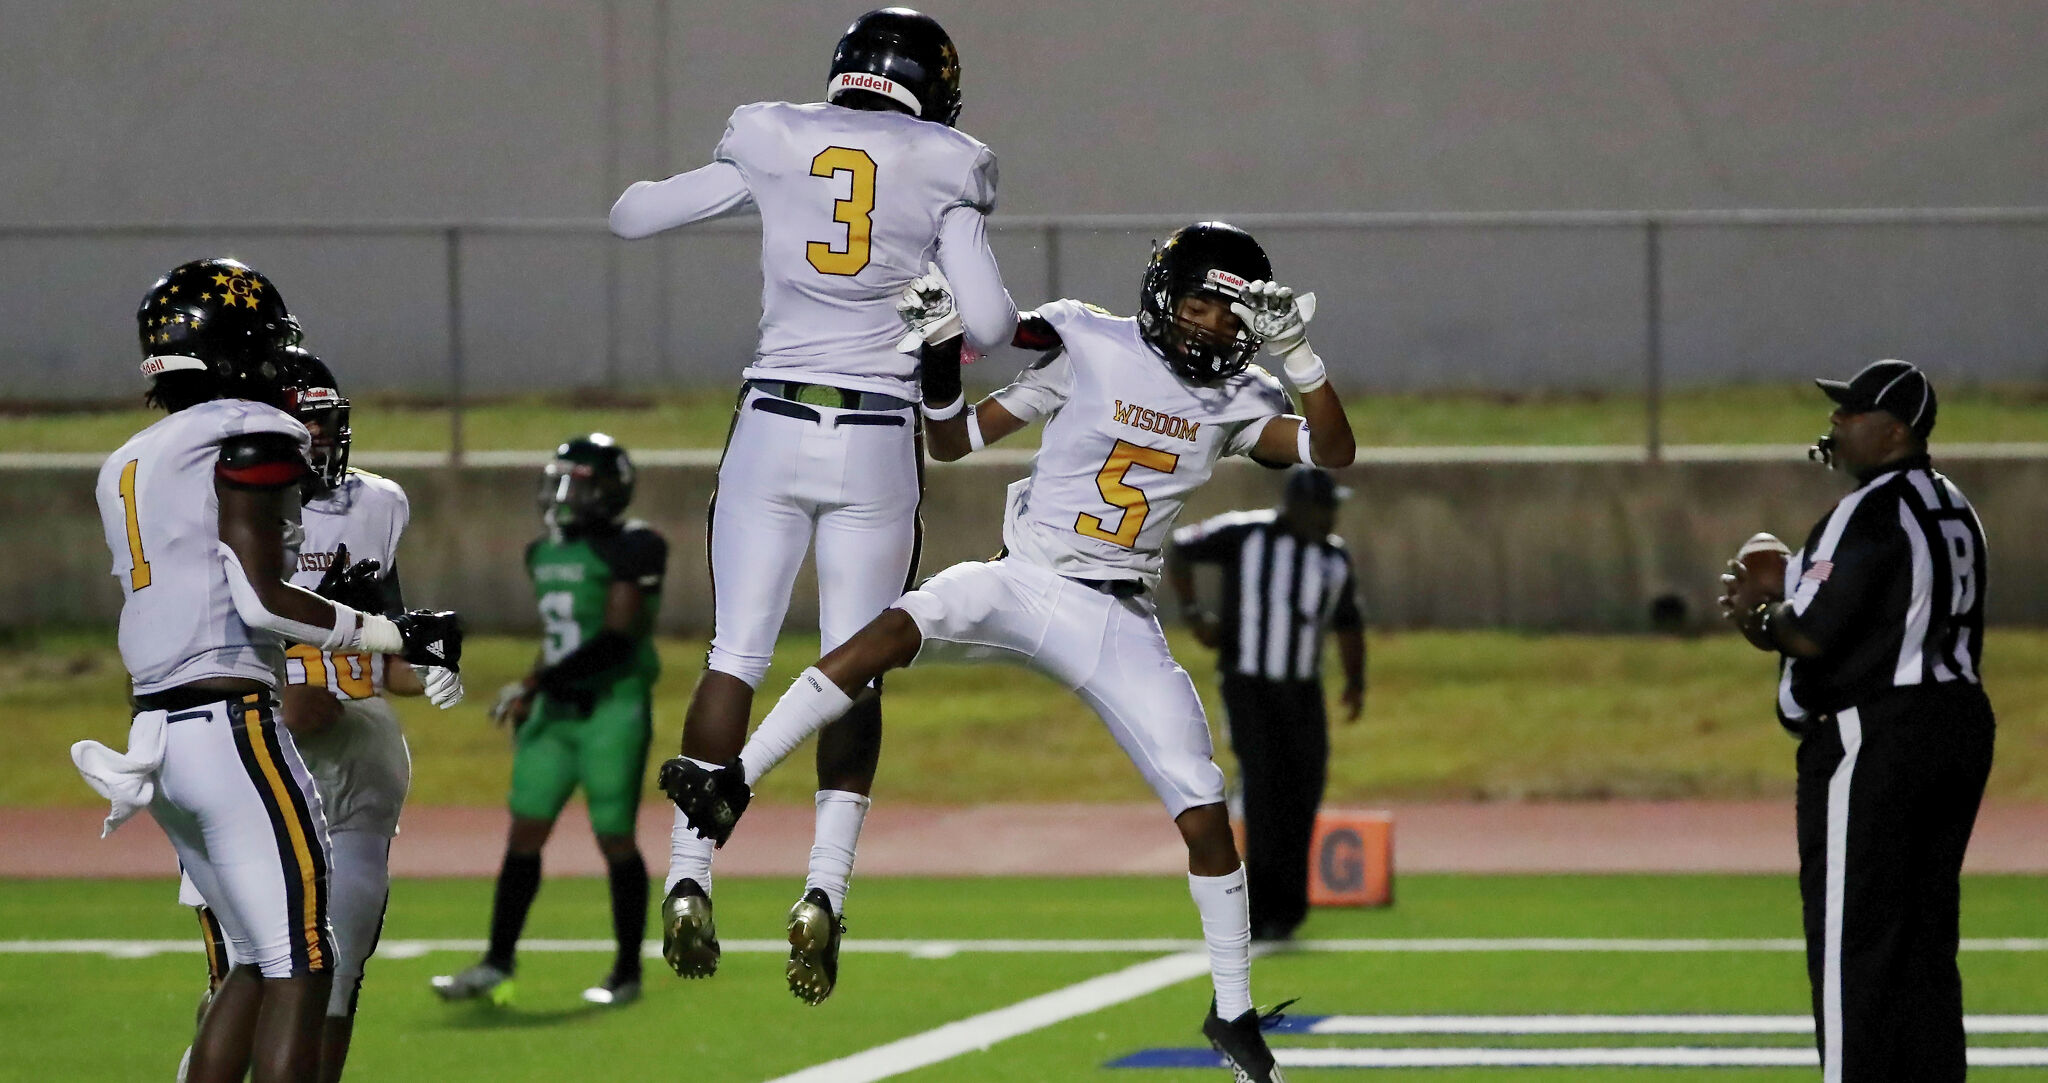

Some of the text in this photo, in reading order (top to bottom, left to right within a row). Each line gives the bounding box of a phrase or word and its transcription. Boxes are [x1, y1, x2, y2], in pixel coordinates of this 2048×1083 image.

[841, 74, 893, 94] Riddell
[806, 145, 878, 277] 3
[1218, 272, 1244, 287] Riddell
[1113, 399, 1200, 442] WISDOM
[119, 458, 152, 593] 1
[1074, 438, 1180, 548] 5
[1320, 828, 1364, 894] G
